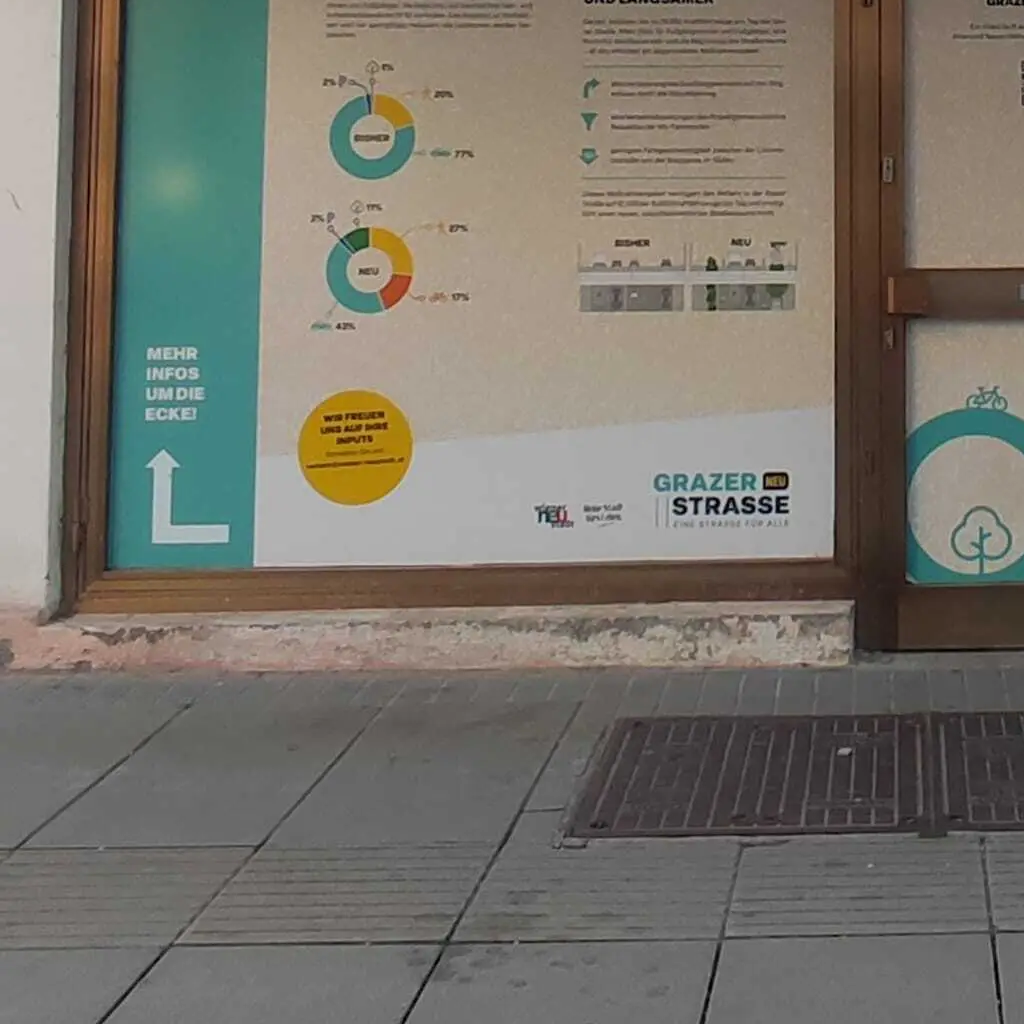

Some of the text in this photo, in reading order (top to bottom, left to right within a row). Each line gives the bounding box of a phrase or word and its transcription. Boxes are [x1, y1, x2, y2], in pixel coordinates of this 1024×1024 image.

[146, 346, 198, 361] MEHR
[146, 366, 200, 381] INFOS
[145, 386, 205, 401] UM DIE
[653, 472, 757, 492] GRAZER
[672, 495, 790, 516] STRASSE
